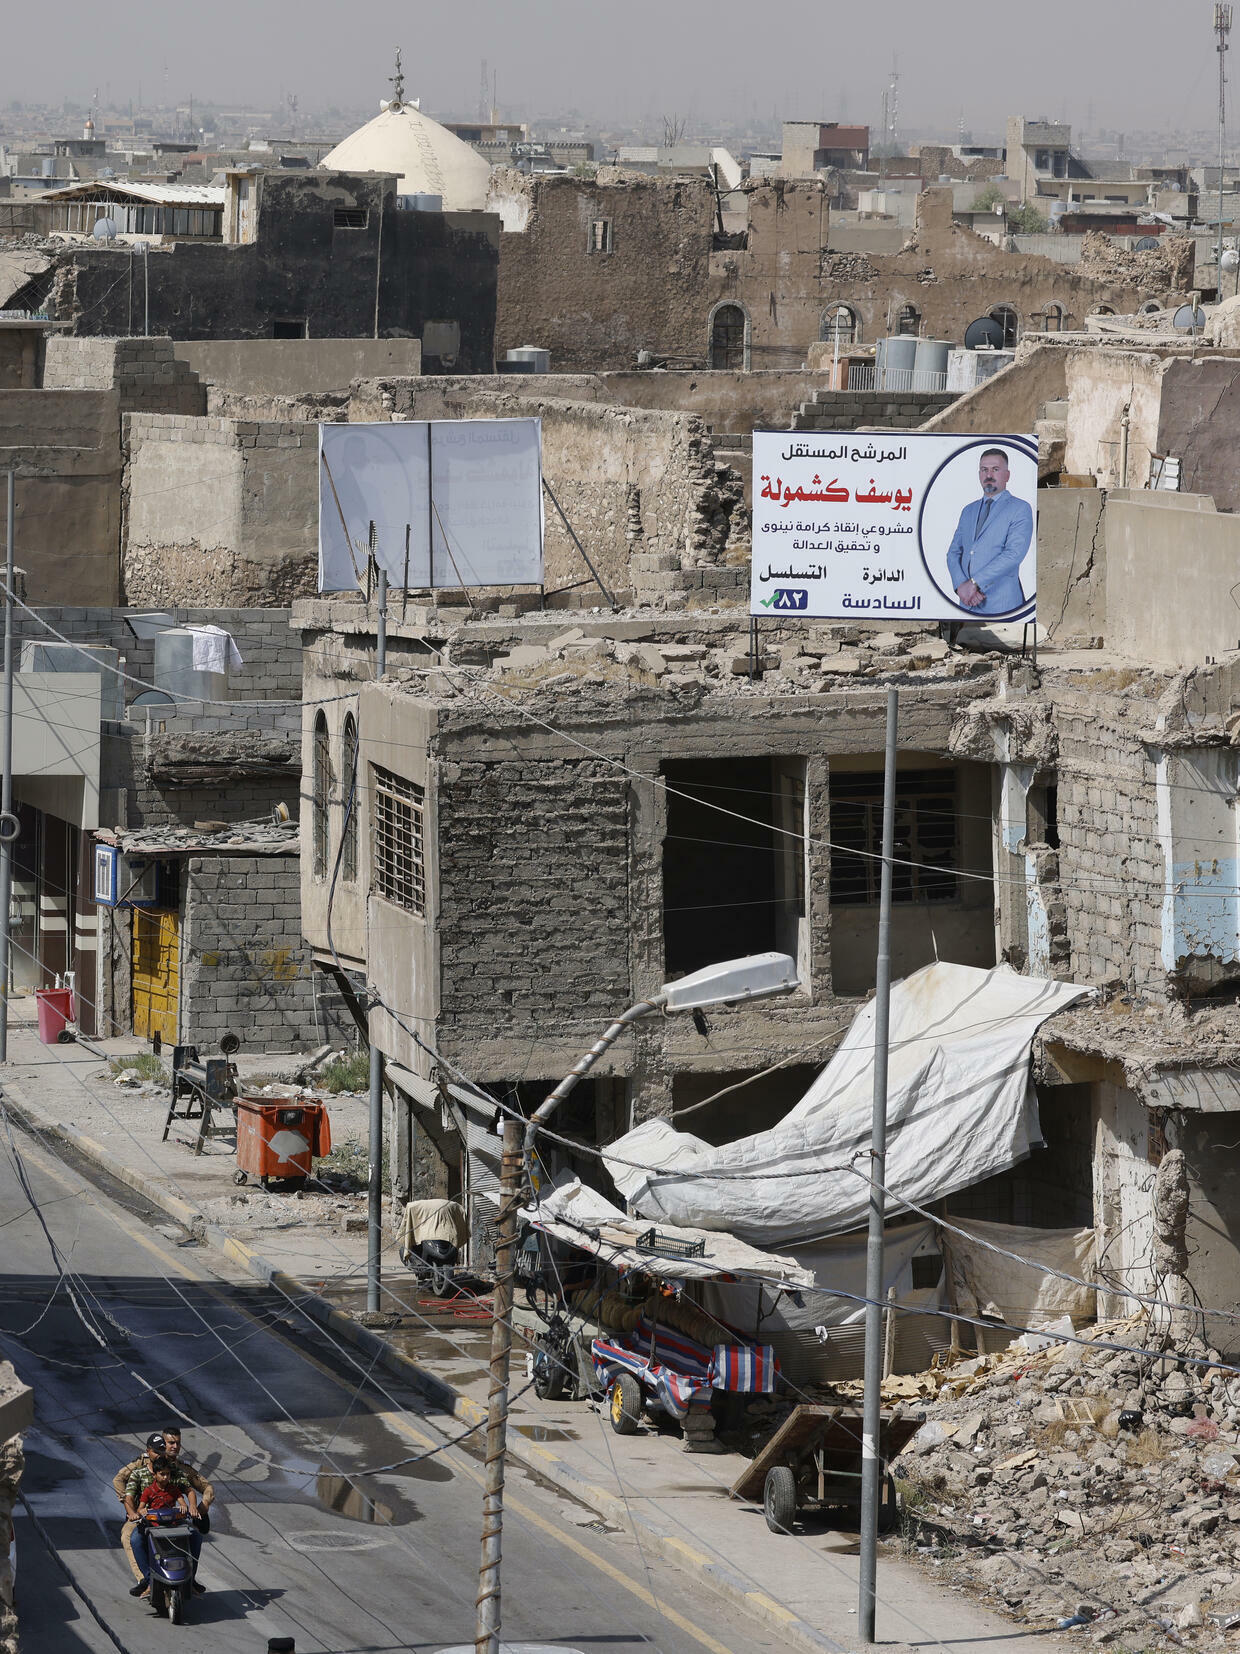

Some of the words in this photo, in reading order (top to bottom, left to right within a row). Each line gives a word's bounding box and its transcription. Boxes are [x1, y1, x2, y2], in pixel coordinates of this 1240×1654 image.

[781, 443, 848, 461] المستقل
[850, 442, 907, 463] المرشح
[760, 473, 850, 508] كشمولة
[854, 478, 913, 512] يوسف
[761, 520, 794, 534] نينوى
[795, 520, 831, 534] كرامة
[833, 521, 860, 536] إنقاذ
[861, 522, 914, 539] مشروعي
[792, 539, 833, 550] العدالة
[834, 540, 871, 554] تحقيق
[759, 564, 827, 583] التسلسل
[862, 567, 905, 586] الدائرة
[778, 590, 803, 608] ٨٢
[841, 593, 921, 610] السادسة
